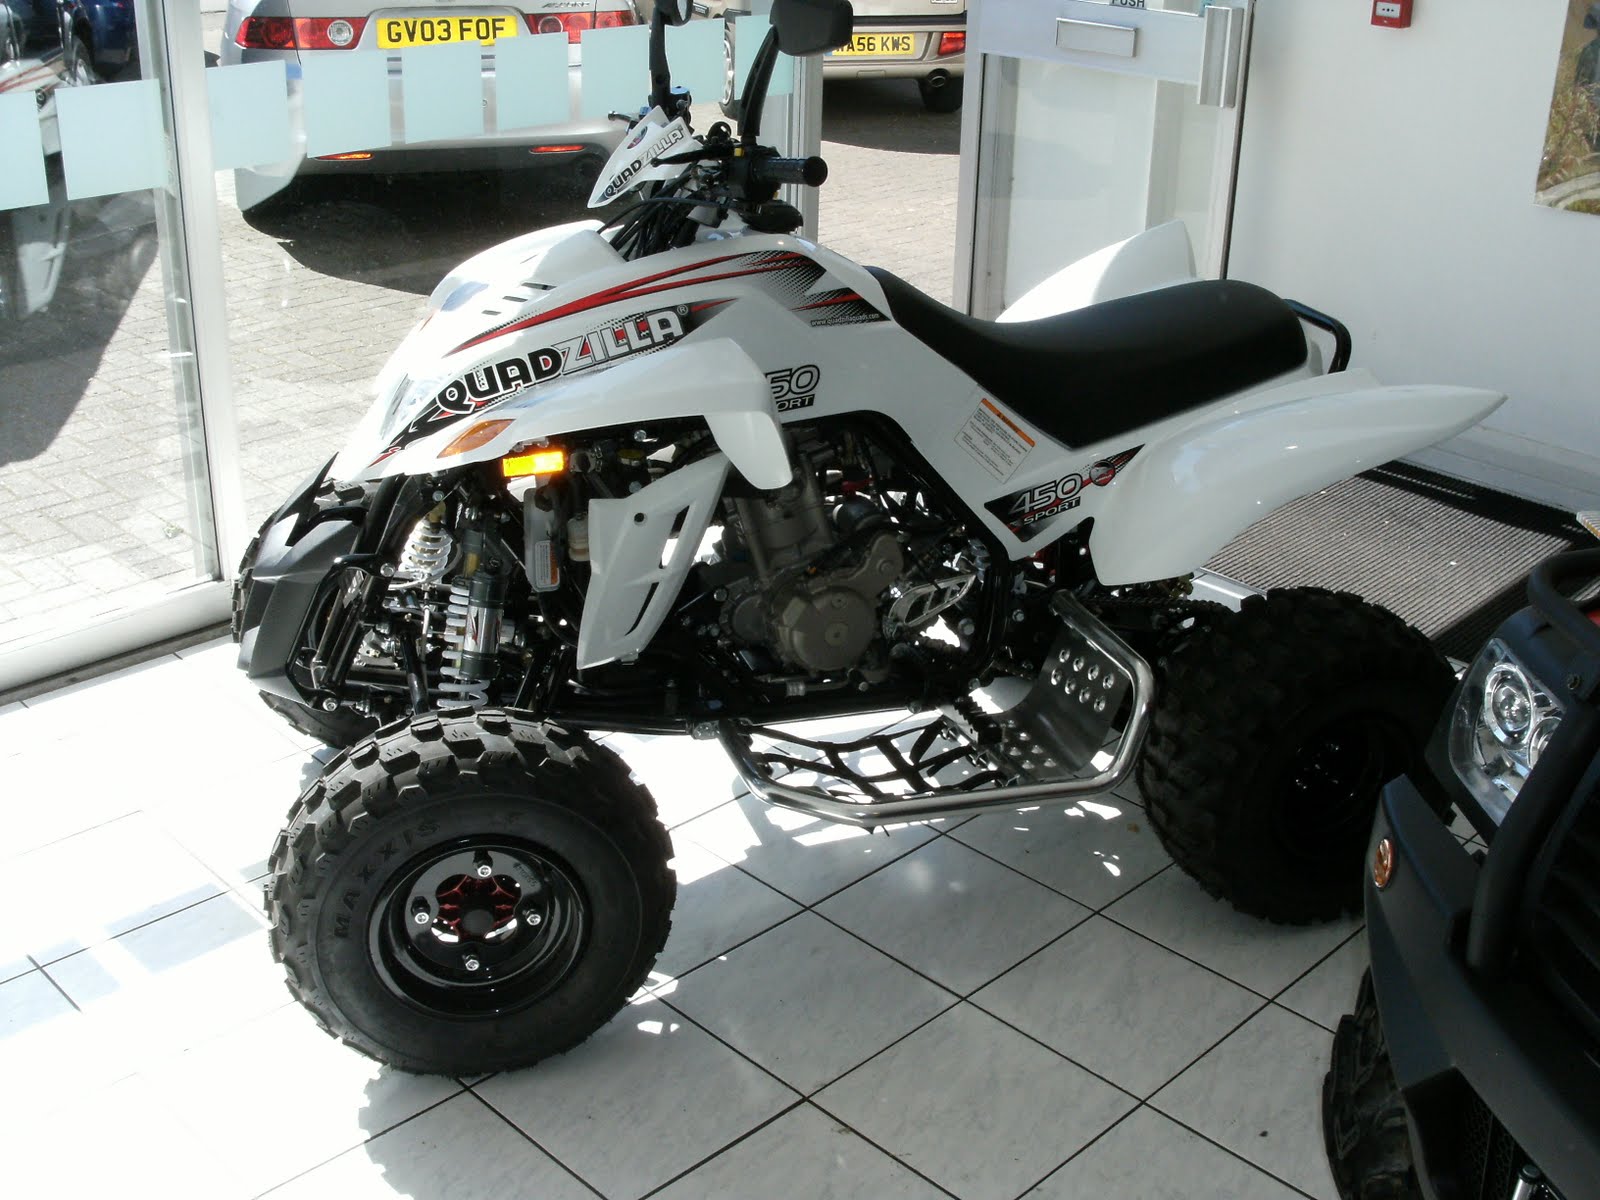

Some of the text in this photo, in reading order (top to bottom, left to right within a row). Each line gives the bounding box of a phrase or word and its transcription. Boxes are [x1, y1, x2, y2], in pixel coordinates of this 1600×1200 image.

[387, 18, 451, 43] GV03
[836, 36, 910, 52] A56 KWS
[763, 364, 820, 400] 50
[777, 395, 814, 412] ORT
[1008, 472, 1083, 514] 450
[1024, 497, 1080, 526] SPORT
[333, 821, 441, 938] MAXXIS
